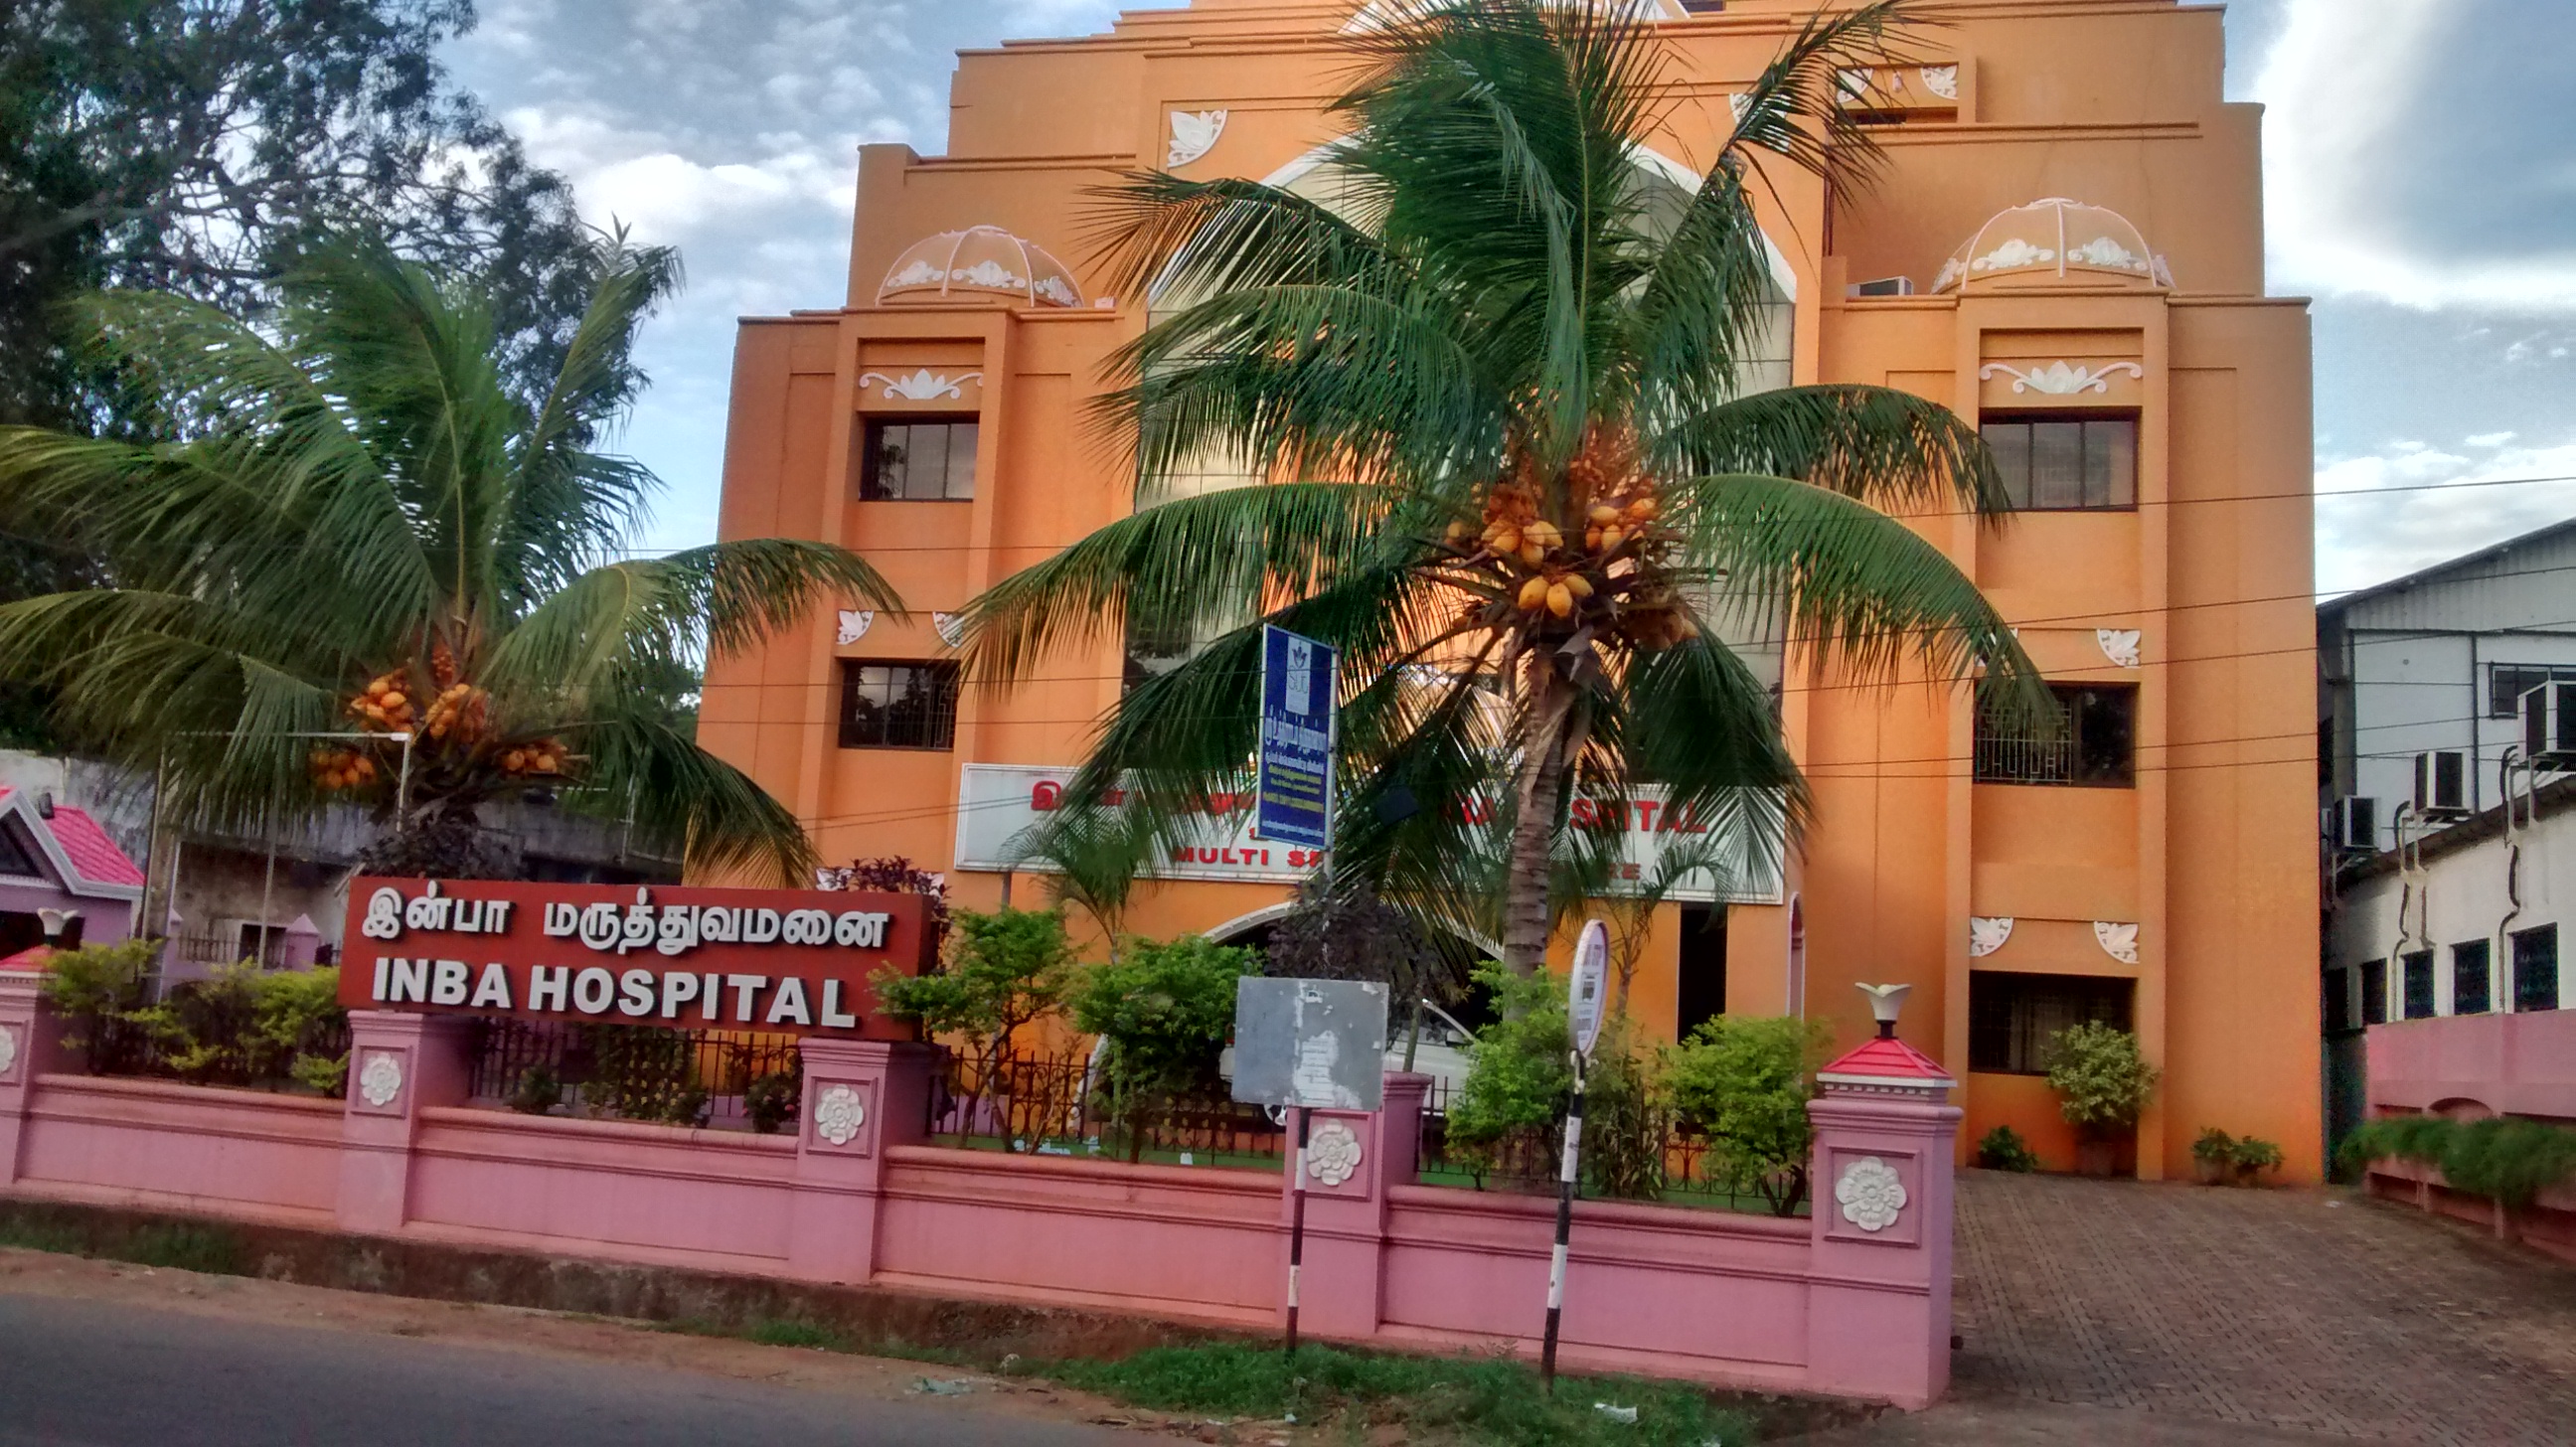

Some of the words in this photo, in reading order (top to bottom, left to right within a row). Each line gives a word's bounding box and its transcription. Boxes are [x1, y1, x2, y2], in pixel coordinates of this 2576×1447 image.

[1176, 847, 1269, 867] MULTI
[362, 880, 511, 939] இன்பா
[544, 886, 889, 955] மருத்துவமனை
[372, 957, 512, 1009] INBA
[529, 964, 857, 1029] HOSPITAL
